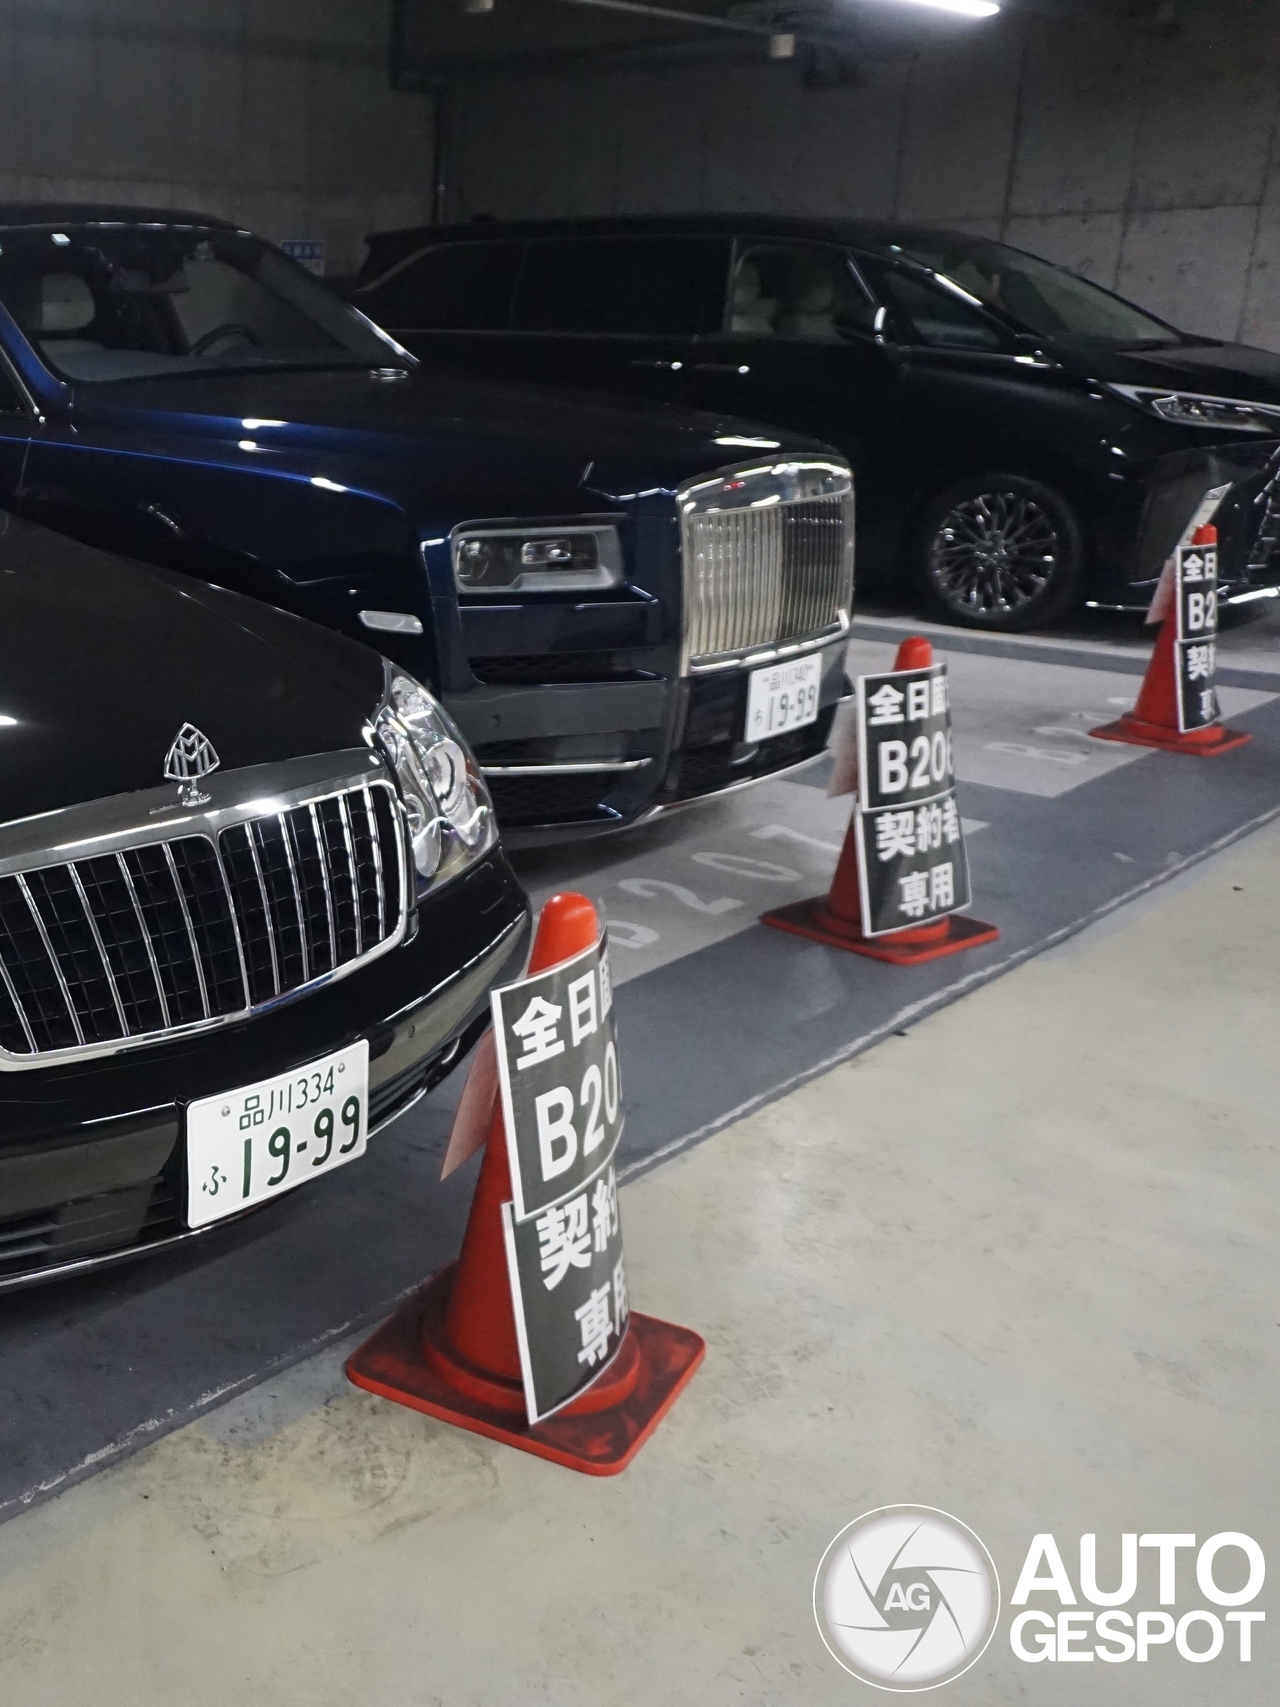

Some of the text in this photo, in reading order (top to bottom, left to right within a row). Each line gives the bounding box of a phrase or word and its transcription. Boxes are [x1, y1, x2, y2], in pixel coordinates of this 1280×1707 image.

[768, 684, 816, 731] 19-99
[898, 862, 954, 917] 専用
[202, 1095, 360, 1199] ふ 19-99
